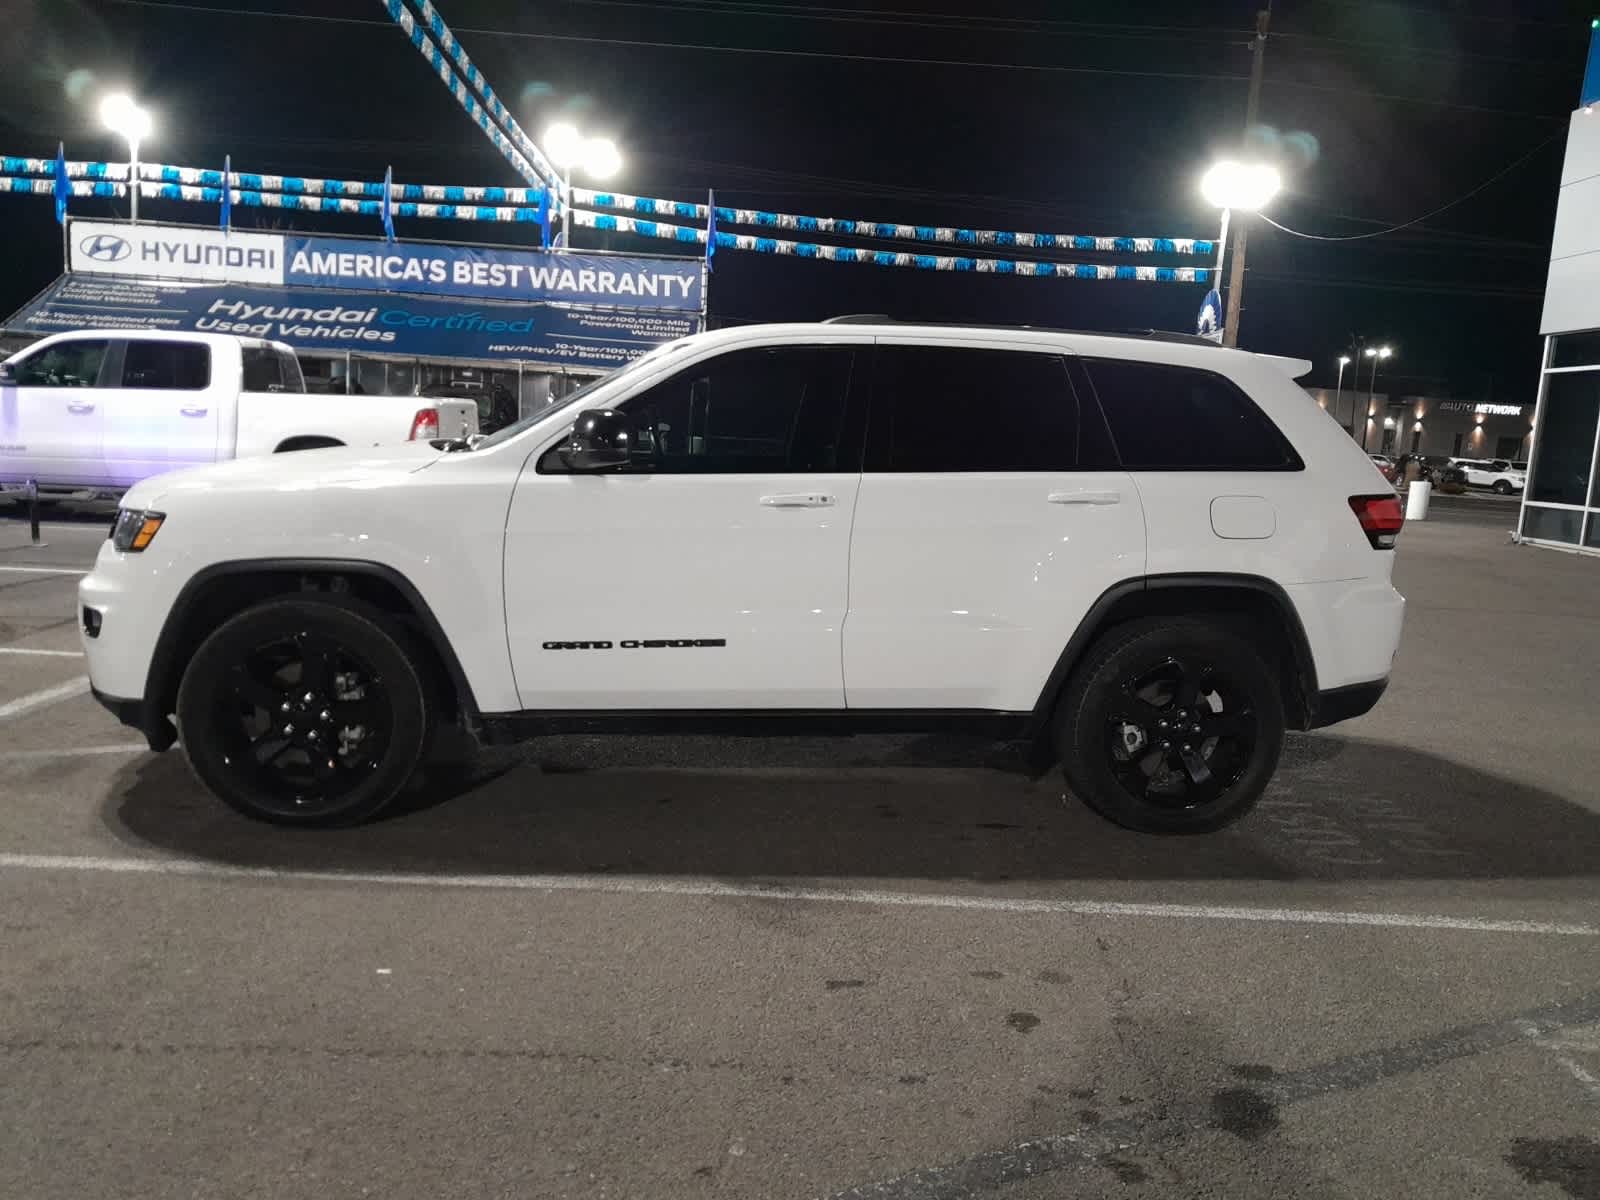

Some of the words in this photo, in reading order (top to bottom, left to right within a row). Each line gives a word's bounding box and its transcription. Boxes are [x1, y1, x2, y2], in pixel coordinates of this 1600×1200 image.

[141, 240, 274, 270] HYUNDAI
[290, 249, 447, 283] AMERICA'S
[453, 261, 524, 287] BEST
[531, 268, 695, 297] WARRANTY
[208, 299, 377, 323] Hyundai
[379, 311, 534, 332] Certified
[195, 318, 272, 336] Used
[279, 323, 396, 341] Vehicles
[580, 319, 644, 330] Powertrain
[646, 324, 690, 333] Limited
[631, 329, 687, 338] Warranty
[488, 344, 576, 357] HEV/PHEV/EV
[578, 351, 625, 361] Battery
[1475, 403, 1522, 416] NETWORK
[542, 640, 613, 650] GRAND
